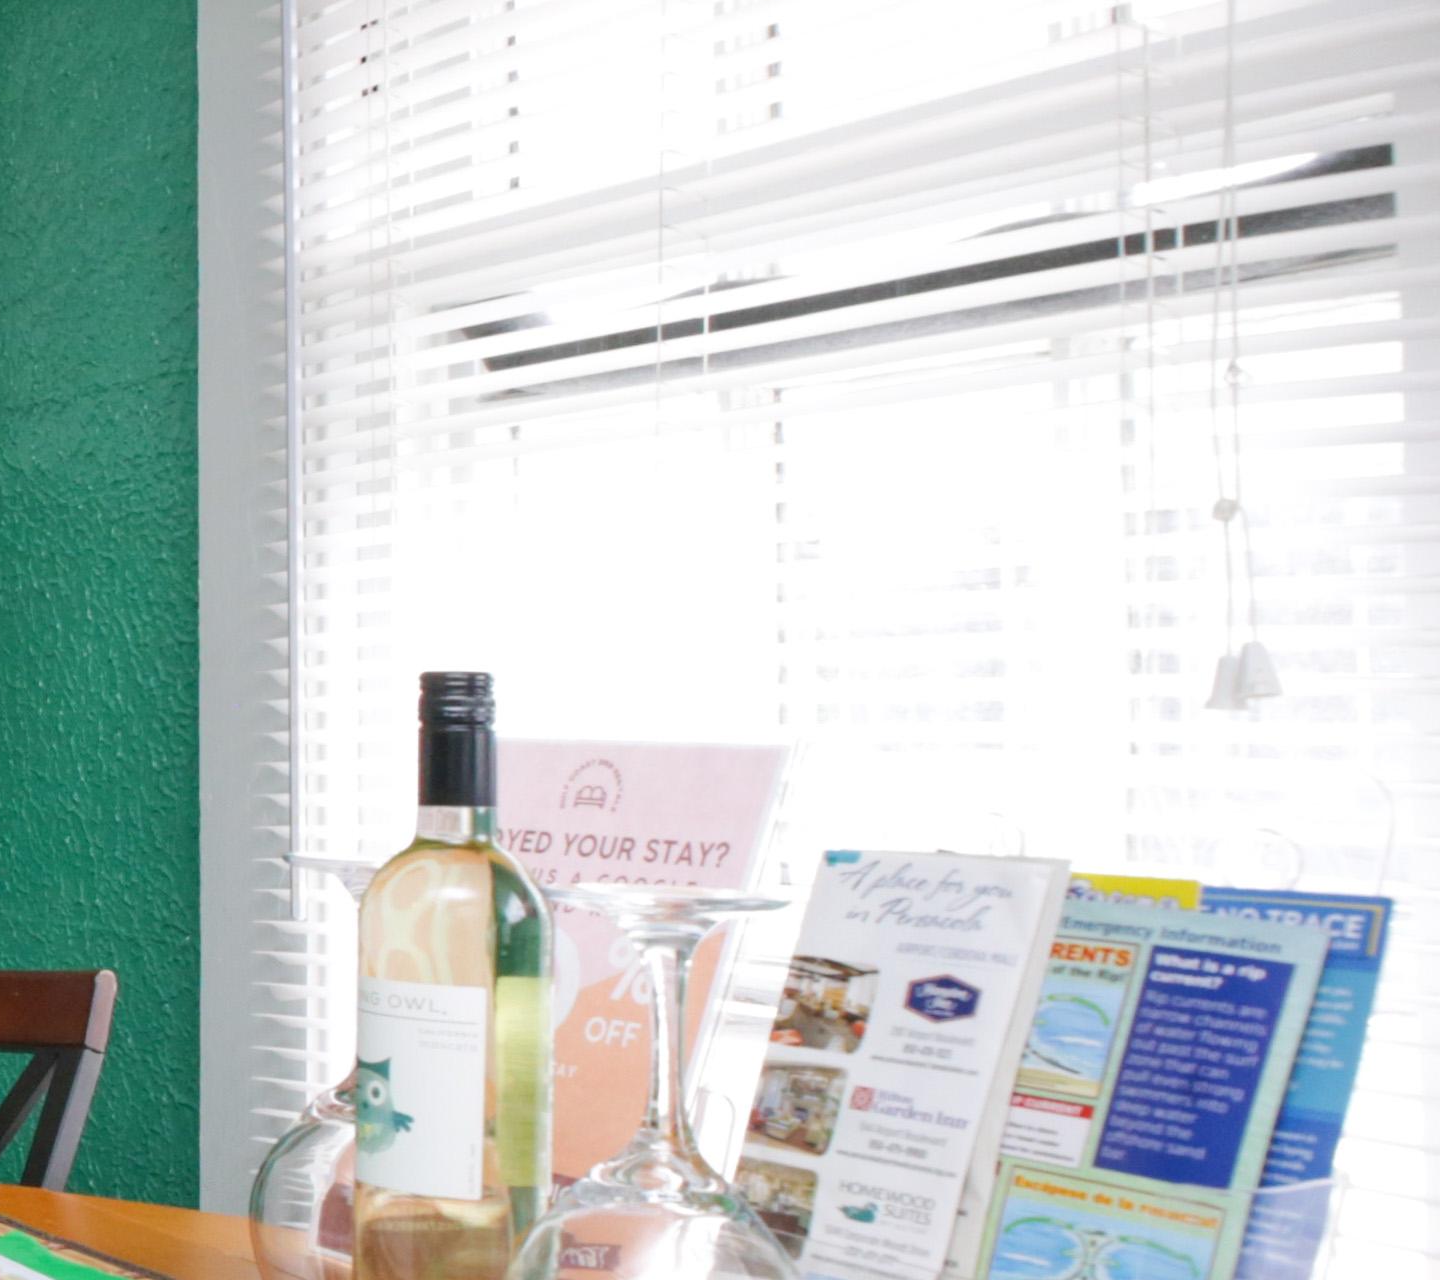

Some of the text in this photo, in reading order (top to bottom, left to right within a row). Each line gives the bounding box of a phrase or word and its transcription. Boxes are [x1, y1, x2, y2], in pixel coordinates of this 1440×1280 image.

[563, 833, 636, 861] YOUR
[643, 836, 730, 868] STAY?
[1061, 915, 1153, 939] Emergency
[1050, 942, 1132, 967] RENTS
[584, 1016, 641, 1048] OFF
[839, 1180, 937, 1210] HOMEWOOD
